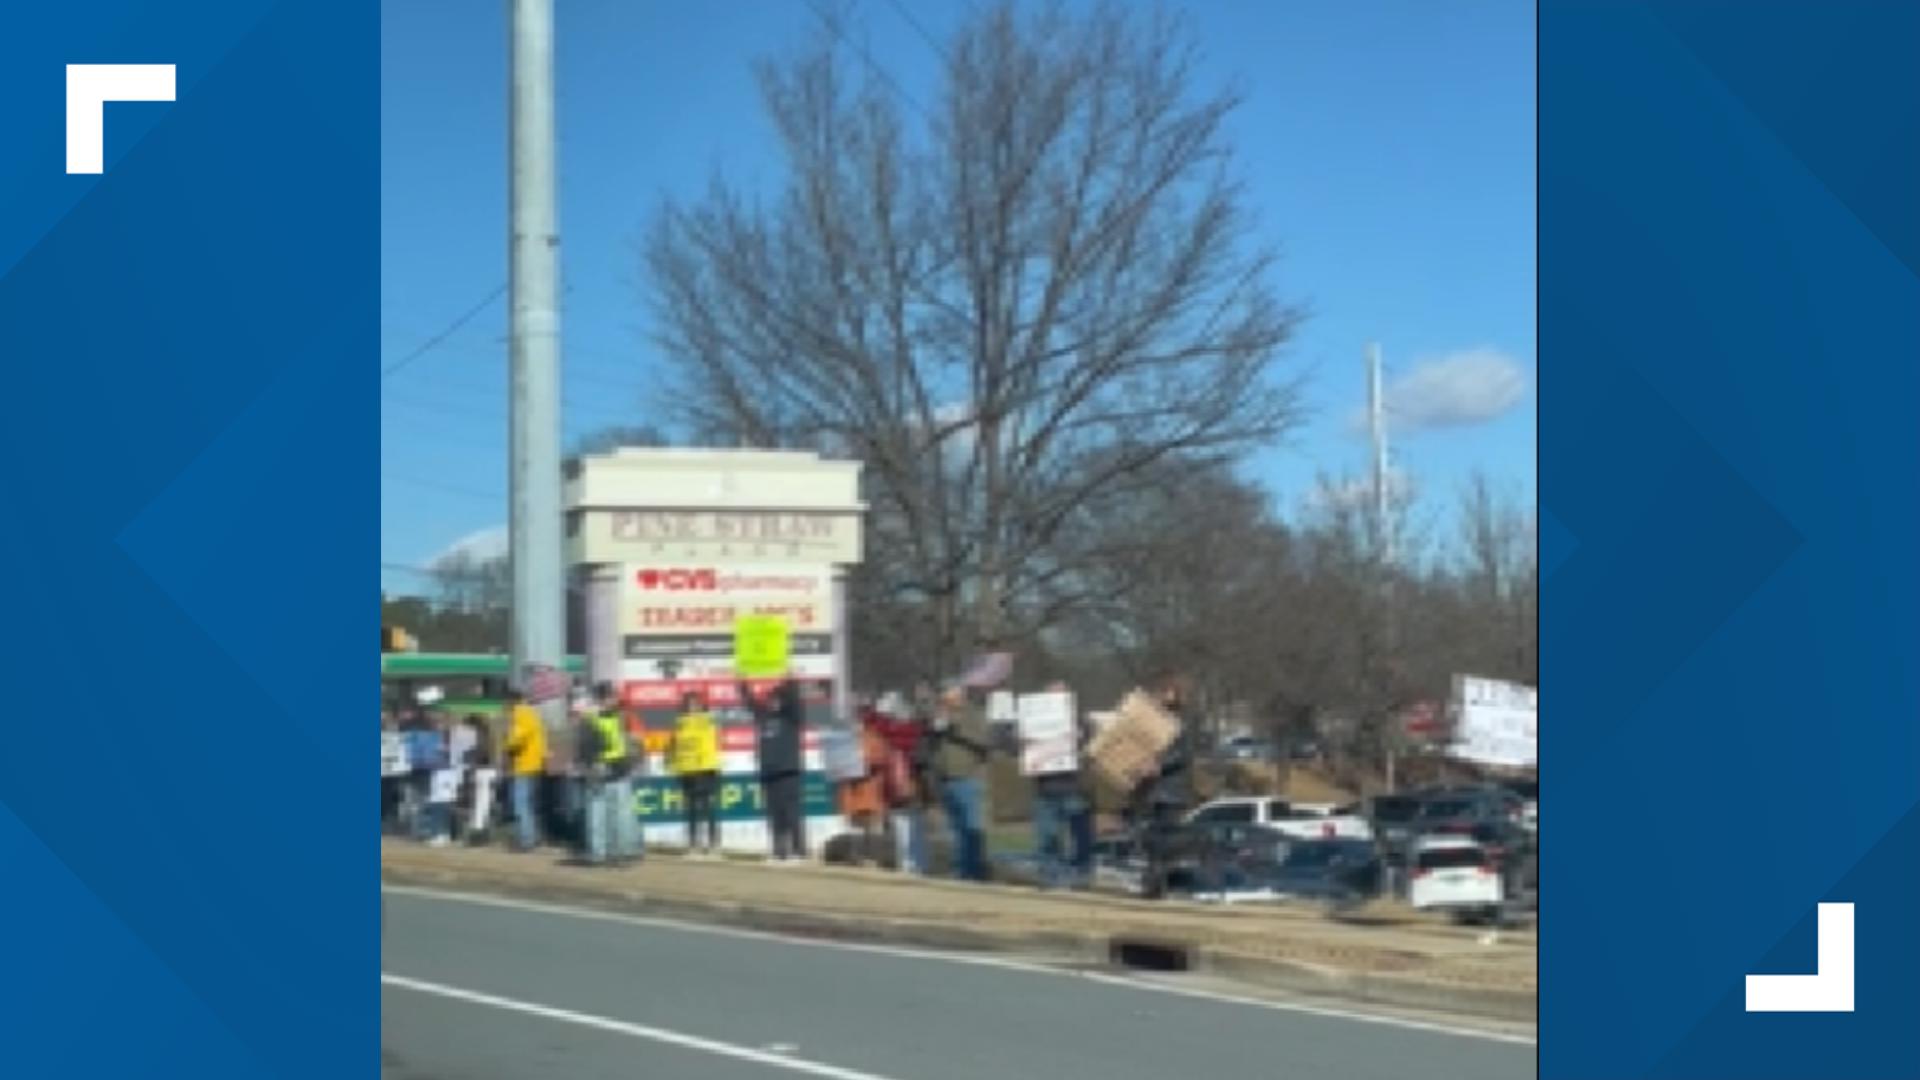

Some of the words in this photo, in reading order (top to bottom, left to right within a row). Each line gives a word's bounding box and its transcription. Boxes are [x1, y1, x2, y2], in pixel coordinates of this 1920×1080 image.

[663, 568, 716, 591] CVS
[717, 571, 818, 594] pharmacy
[634, 783, 767, 815] CHPT
